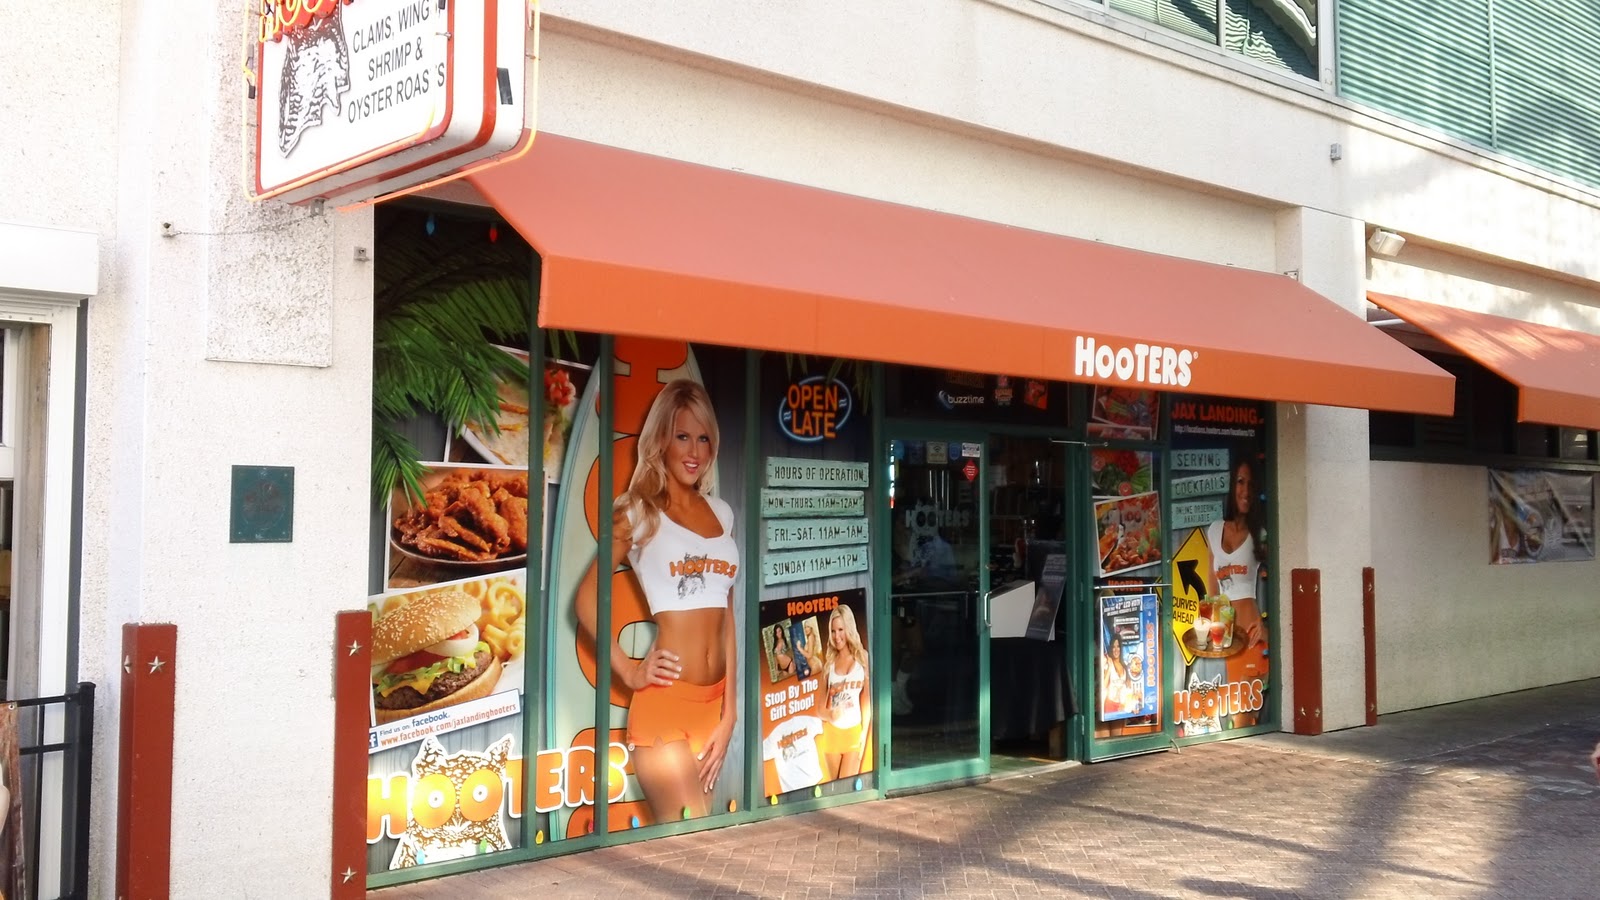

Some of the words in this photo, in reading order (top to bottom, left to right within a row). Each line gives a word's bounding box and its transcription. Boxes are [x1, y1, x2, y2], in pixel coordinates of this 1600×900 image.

[398, 0, 441, 33] WING
[367, 41, 412, 82] SHRIMP
[415, 36, 424, 61] &
[347, 85, 393, 124] OYSTER
[396, 62, 446, 105] ROASS
[1075, 336, 1192, 387] HOOTERS
[787, 383, 838, 411] OPEN
[947, 394, 984, 405] buzztime
[1171, 402, 1197, 420] JAX
[1199, 404, 1258, 424] LANDING
[791, 411, 837, 439] LATE
[1176, 453, 1221, 467] SERVING
[774, 465, 803, 480] HOURS
[805, 466, 817, 480] OF
[819, 467, 864, 482] OPERATION
[1175, 476, 1226, 496] COCKTAILS
[774, 526, 816, 542] FRI.-SAT.
[818, 525, 863, 541] 11AM-1AM
[669, 558, 738, 579] HOOTERS
[772, 559, 807, 577] SUNDAY
[809, 553, 859, 572] 11AM-11PM
[786, 596, 839, 617] HOOTERS
[1172, 596, 1198, 612] CURVES
[1173, 610, 1195, 625] AHEAD
[764, 689, 787, 707] Stop
[788, 684, 801, 699] By
[801, 678, 819, 695] The
[1173, 679, 1263, 725] HOOTERS
[770, 702, 788, 722] Gift
[788, 693, 815, 716] Shop!
[379, 728, 393, 737] Find
[380, 703, 517, 747] www.facebook.com/jaxlandinghooters
